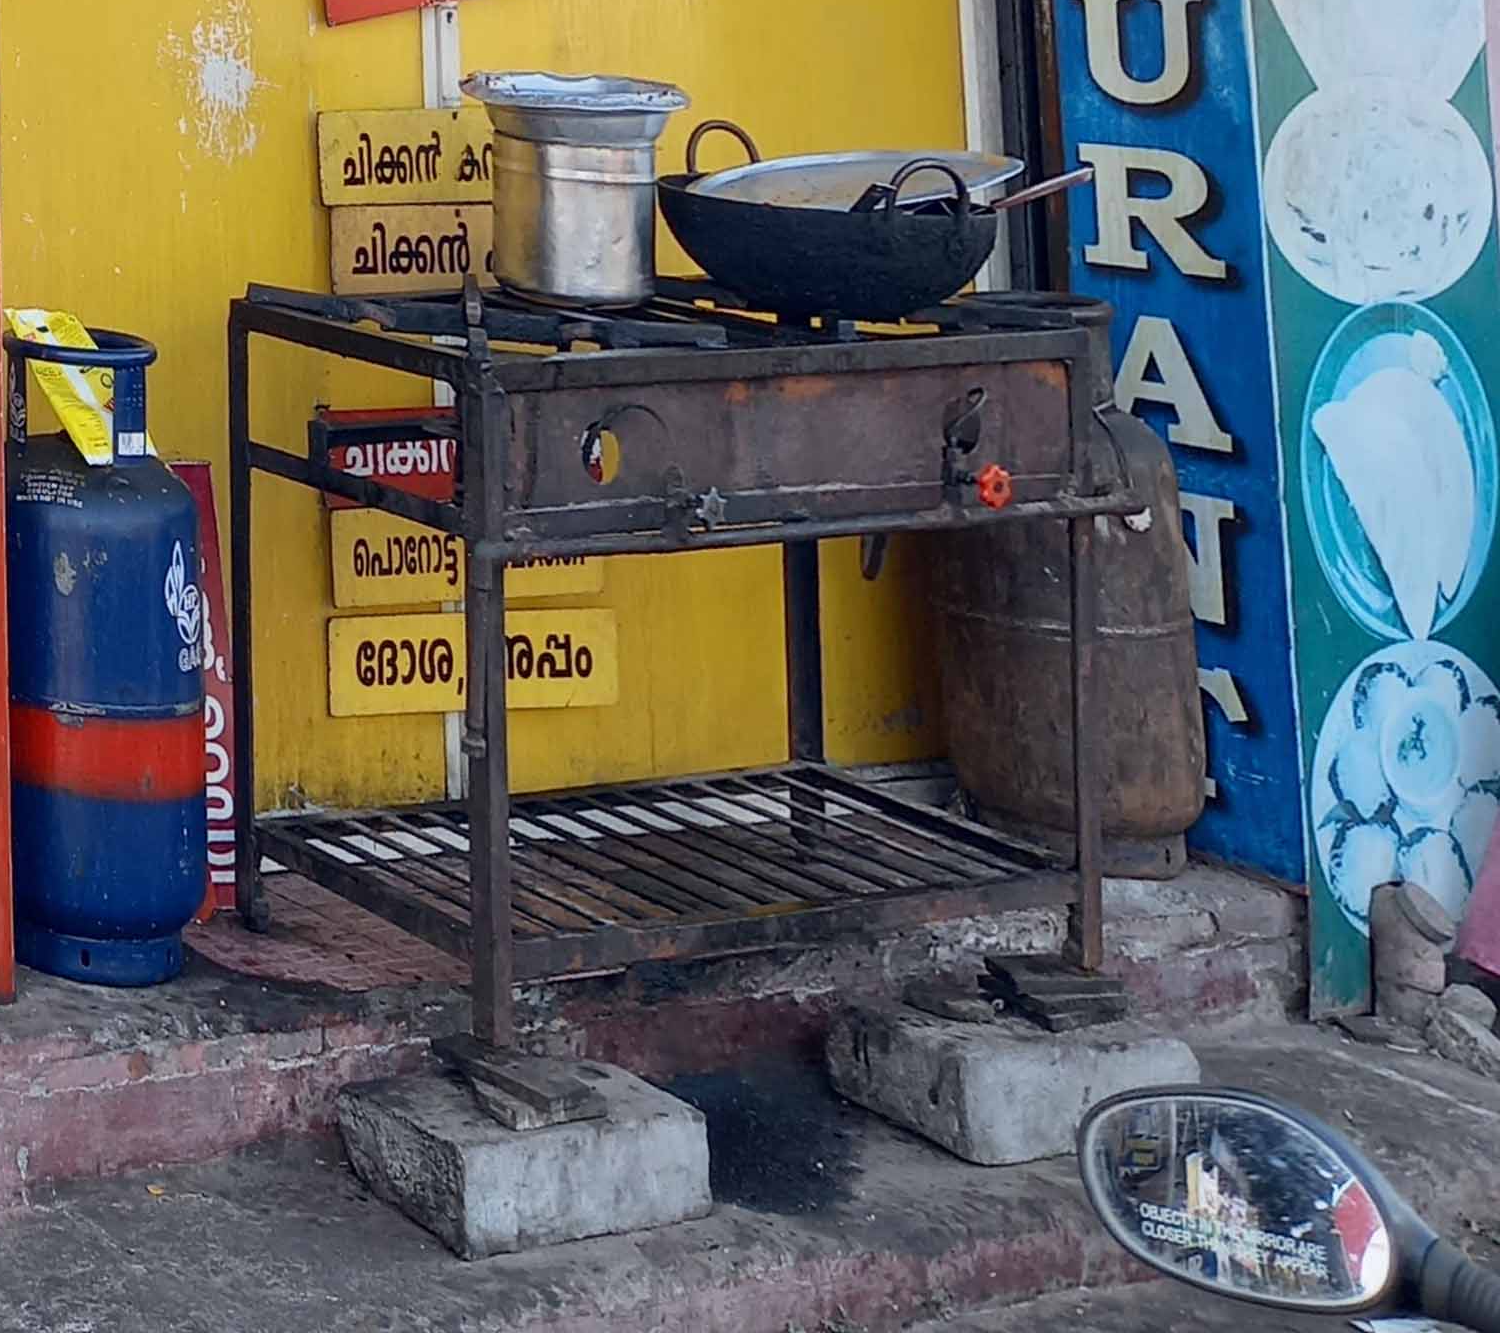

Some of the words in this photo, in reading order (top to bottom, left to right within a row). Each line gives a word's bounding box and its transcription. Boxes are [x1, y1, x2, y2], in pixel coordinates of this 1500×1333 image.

[1140, 1202, 1196, 1230] OBJECTS
[1294, 1237, 1328, 1262] ARE
[1141, 1220, 1192, 1249] CLOSER
[1273, 1248, 1329, 1280] APPEAR
